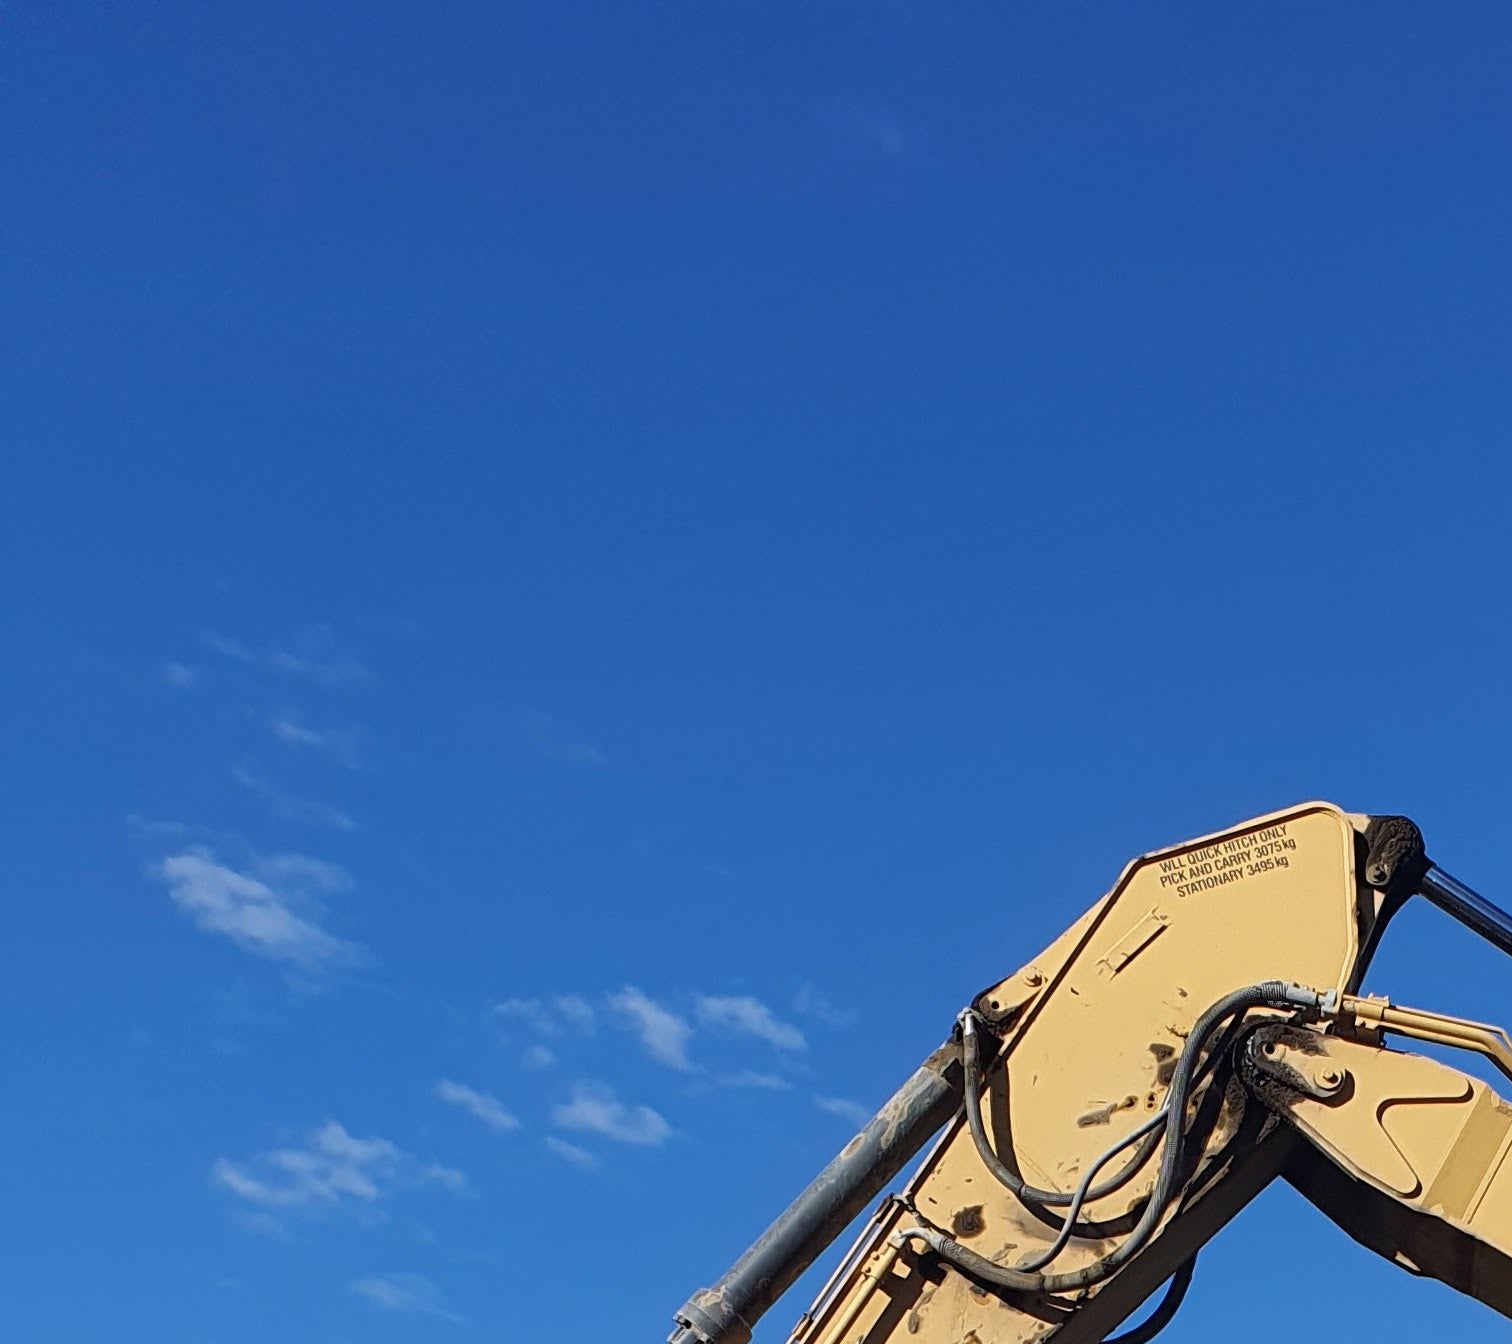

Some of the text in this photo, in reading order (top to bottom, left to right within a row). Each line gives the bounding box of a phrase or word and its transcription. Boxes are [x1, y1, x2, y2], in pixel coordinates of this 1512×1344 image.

[1159, 824, 1287, 873] WLL QUICK HITCH ONLY
[1160, 870, 1187, 888] PICK
[1189, 862, 1213, 879] AND
[1214, 849, 1251, 871] CARRY
[1176, 866, 1243, 897] STATIONARY
